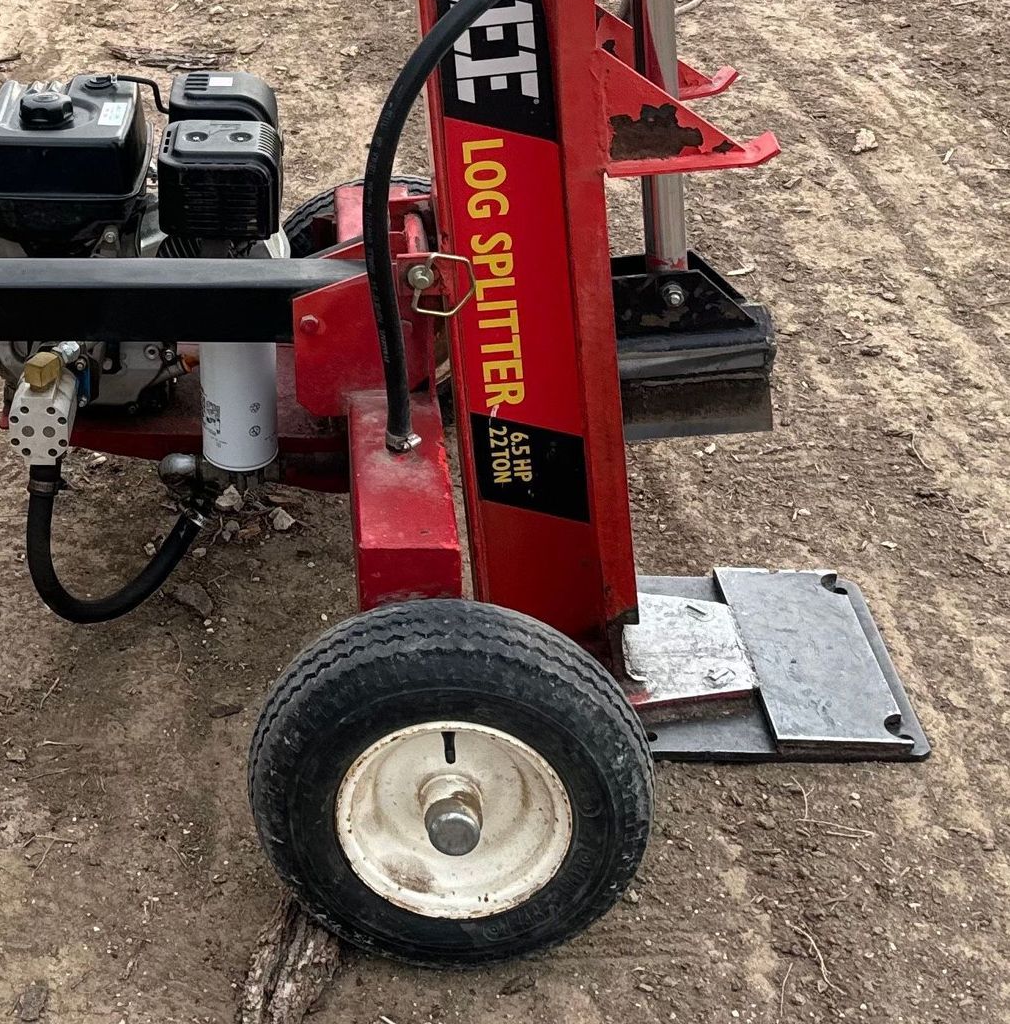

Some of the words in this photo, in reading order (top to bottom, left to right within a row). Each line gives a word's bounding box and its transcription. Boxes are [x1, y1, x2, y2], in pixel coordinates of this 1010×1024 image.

[462, 138, 510, 219] LOG
[470, 231, 526, 408] SPLITTER
[489, 426, 507, 447] 22
[509, 431, 531, 455] 6.5
[490, 448, 512, 484] TON
[512, 458, 533, 483] HP
